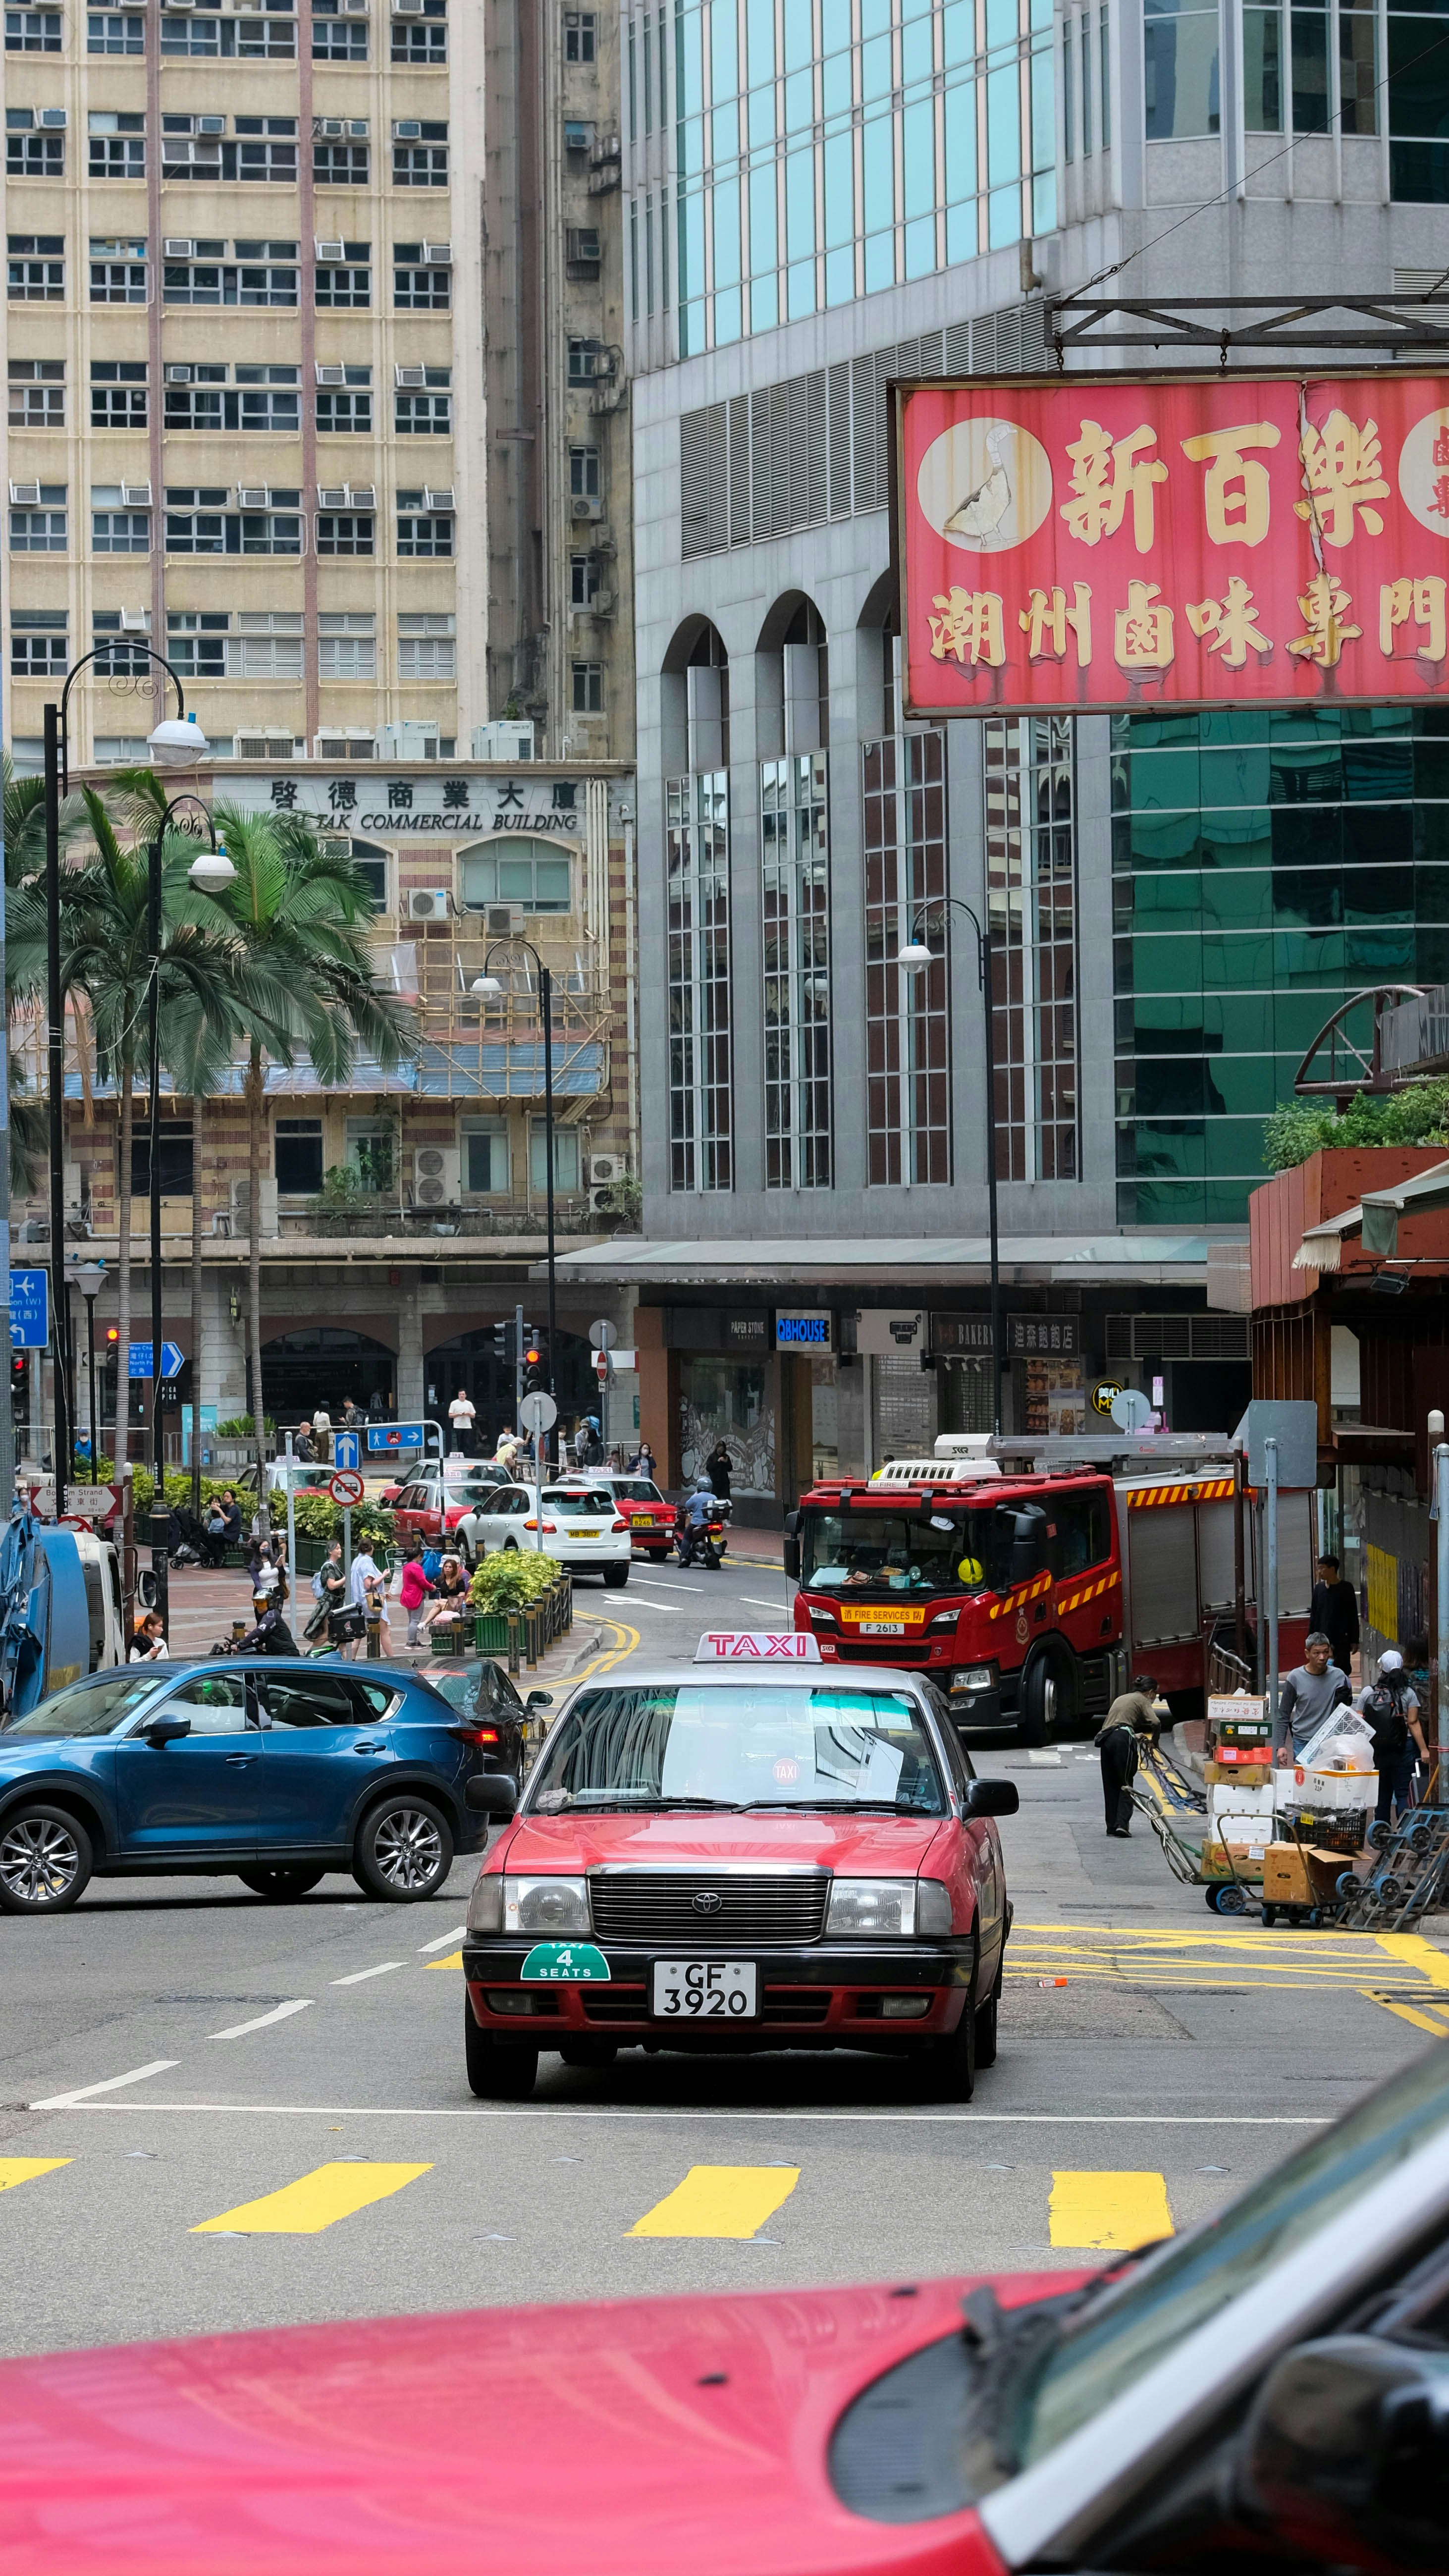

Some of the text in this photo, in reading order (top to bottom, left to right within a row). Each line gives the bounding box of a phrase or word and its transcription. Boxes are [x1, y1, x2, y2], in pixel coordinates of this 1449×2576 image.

[1060, 409, 1390, 554] 新百樂
[927, 572, 1447, 668] 潮州鹵味專門
[317, 814, 351, 830] TAK
[361, 814, 483, 830] COMMERCIAL
[492, 814, 577, 830] BUILDING
[731, 1322, 764, 1334] PAPER STONE
[845, 1610, 921, 1621] 消 FIRE SERVICES 防
[866, 1624, 898, 1633] F 2613
[708, 1635, 806, 1657] TAXI
[775, 1765, 798, 1778] TAXI
[557, 1950, 573, 1966] 4
[539, 1969, 591, 1978] SEATS
[685, 1964, 726, 1989] GF
[663, 1988, 747, 2015] 3920
